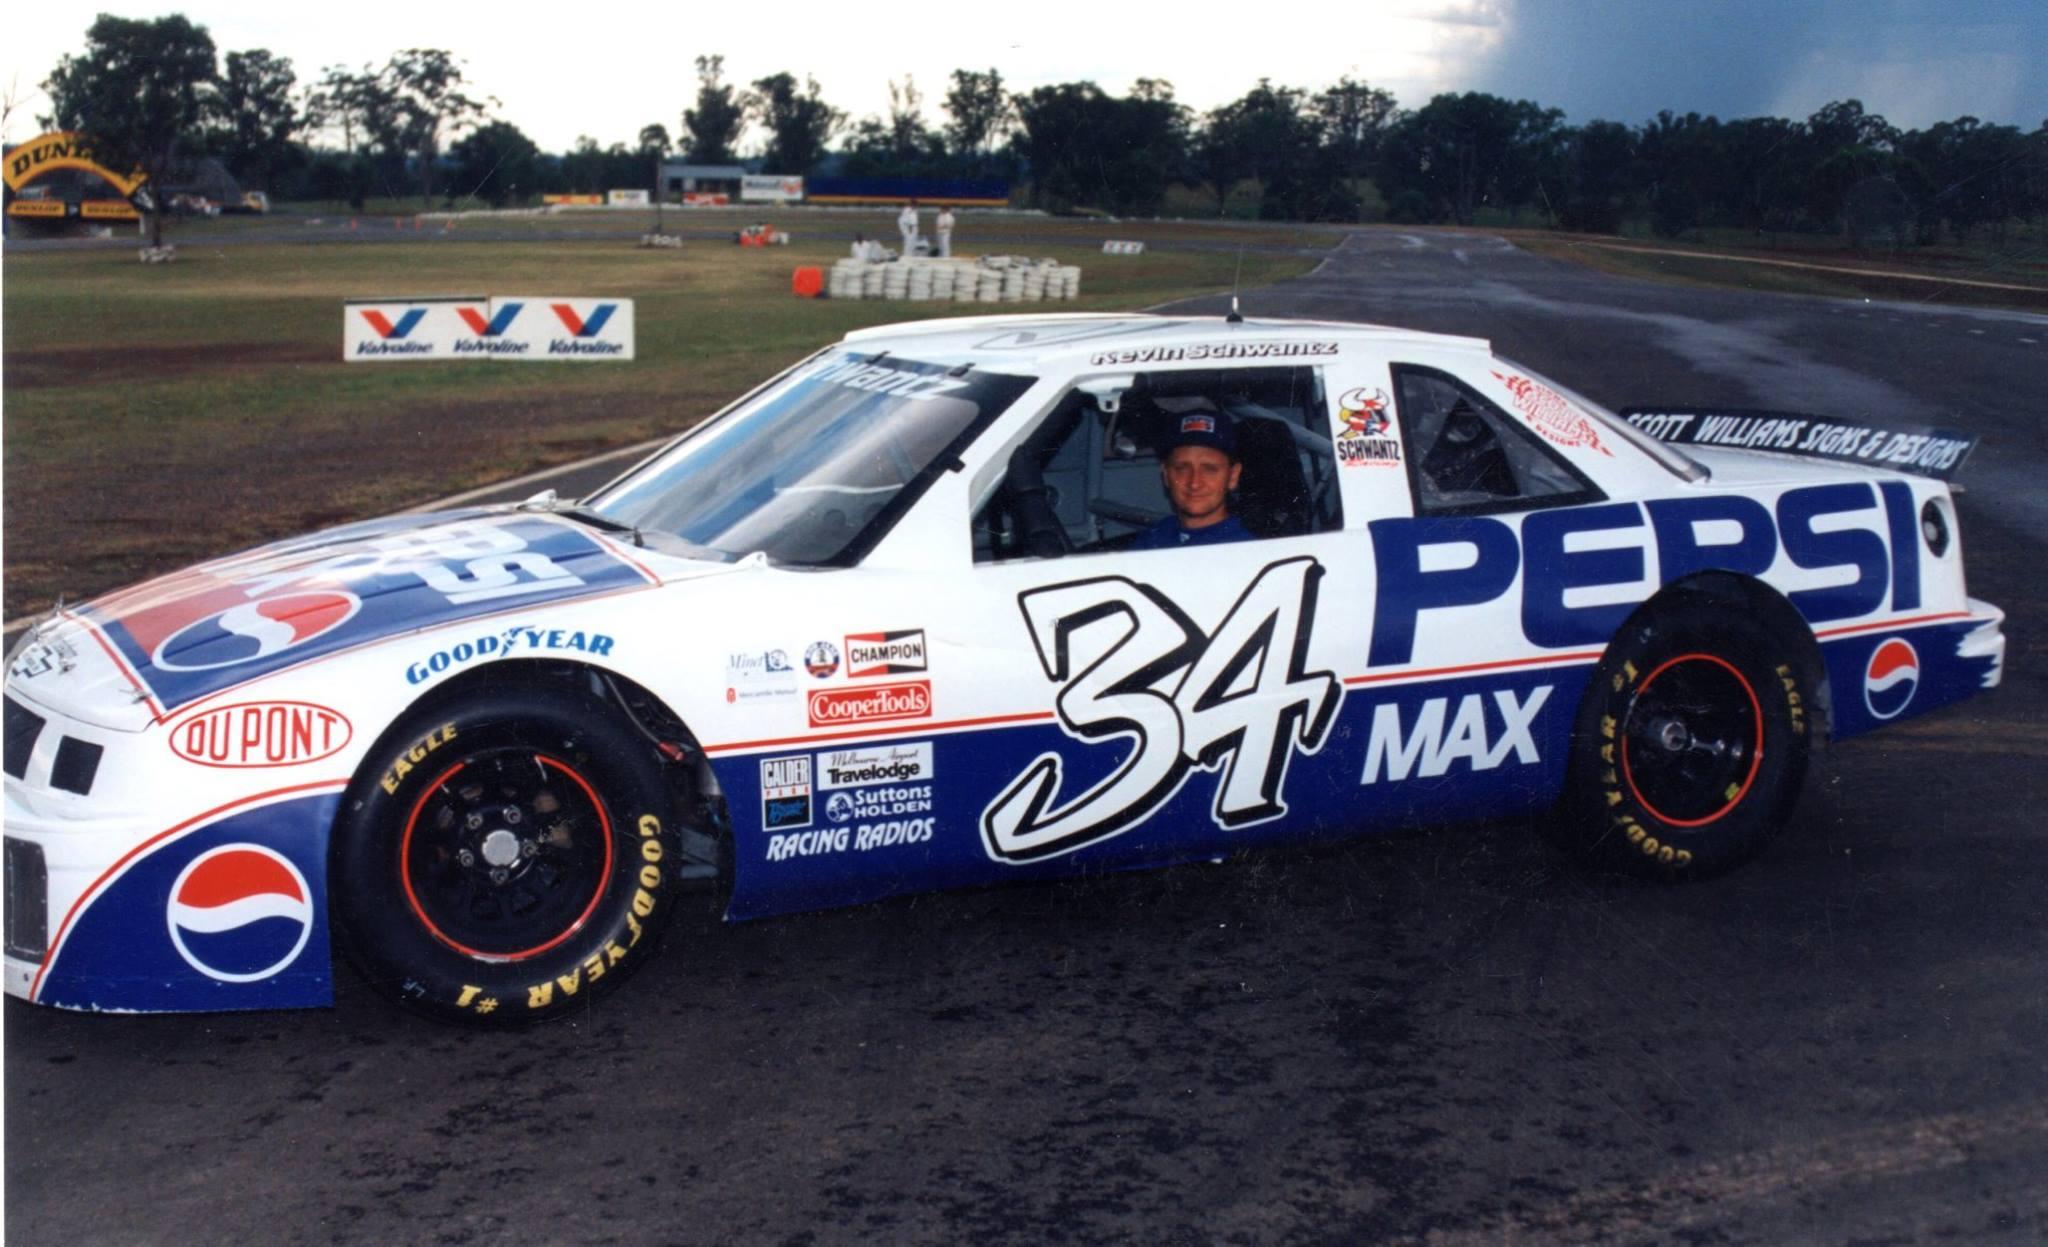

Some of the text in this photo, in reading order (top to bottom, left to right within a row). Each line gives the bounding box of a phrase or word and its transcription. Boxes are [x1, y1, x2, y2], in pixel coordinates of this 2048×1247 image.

[356, 341, 433, 355] Valvoline
[453, 339, 530, 354] Valvoline
[548, 340, 623, 355] Valvoline
[1090, 341, 1340, 366] Kevin Schwantz
[1337, 439, 1401, 461] SCHWANTZ
[1694, 414, 1808, 449] WILLIAMS
[1798, 422, 1869, 454] SIGNS
[1858, 430, 1887, 459] &
[1878, 433, 1970, 469] DESIGNS
[1367, 481, 1921, 668] PEPSI
[851, 643, 922, 664] CHAMPION
[814, 688, 925, 719] CooperTools
[980, 555, 1345, 865] 34
[1775, 664, 1805, 733] EAGLE
[186, 706, 338, 762] DU PONT
[1360, 685, 1554, 785] MAX
[380, 721, 458, 795] EAGLE
[764, 759, 809, 788] CALDER
[827, 763, 921, 785] Travelodge
[854, 785, 932, 805] Suttons
[854, 800, 932, 819] HOLDEN
[766, 817, 936, 862] RACING RADIOS
[527, 814, 663, 1009] GOODYEAR
